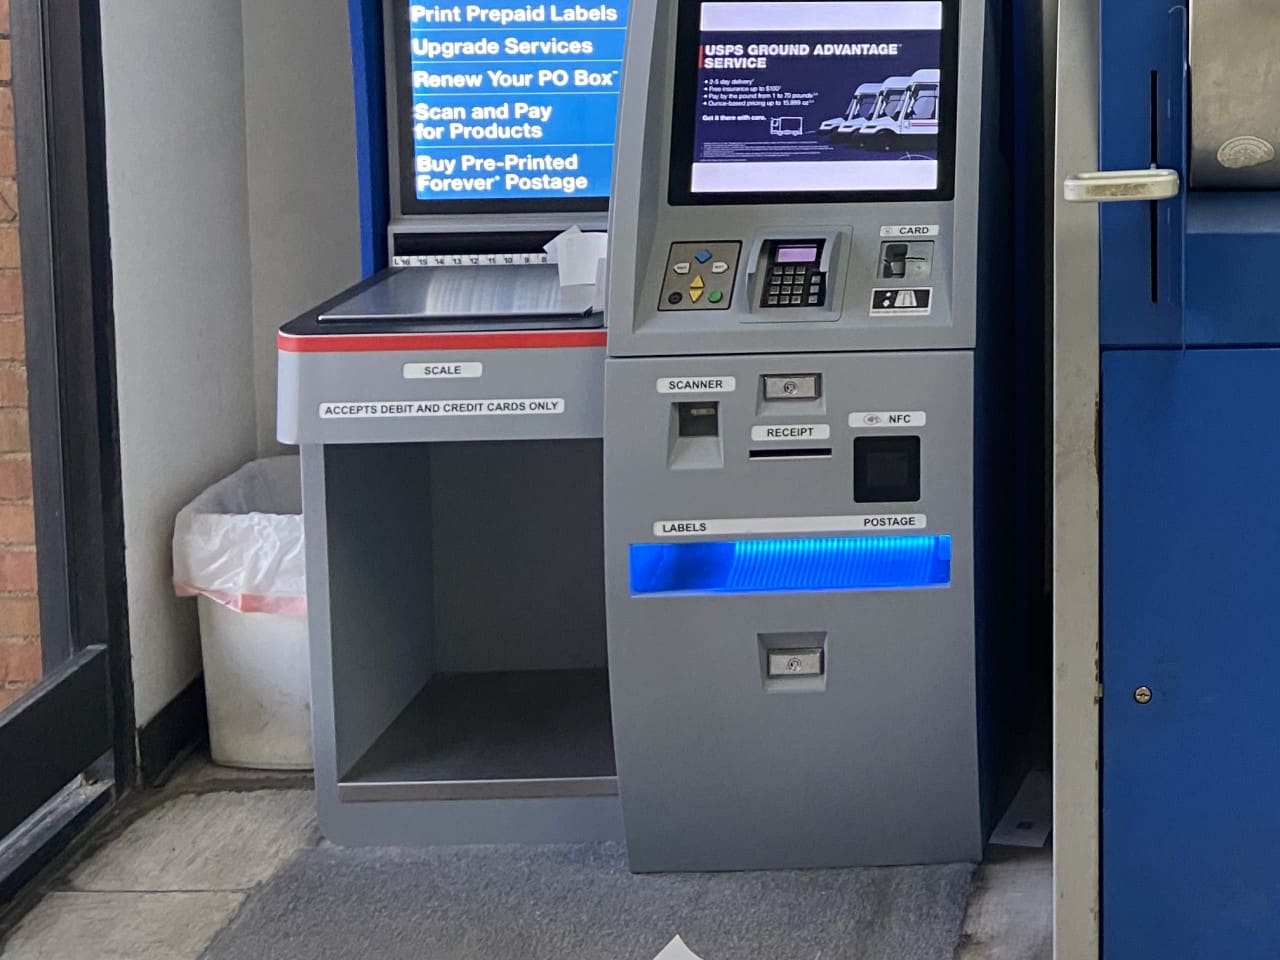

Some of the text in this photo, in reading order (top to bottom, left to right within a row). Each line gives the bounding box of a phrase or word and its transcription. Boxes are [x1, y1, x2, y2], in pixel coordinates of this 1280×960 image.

[410, 4, 617, 25] Print Prepaid Labels
[411, 37, 593, 59] Upgrade Services
[705, 44, 743, 56] USPS
[748, 44, 809, 56] GROUND
[704, 58, 766, 69] SERVICE
[413, 70, 482, 88] Renew
[488, 70, 533, 87] Your
[538, 69, 568, 86] PO
[414, 102, 552, 122] Scan and Pay
[414, 122, 543, 139] for Products
[416, 153, 578, 174] Buy Pre-Printed
[505, 174, 588, 193] Postage
[899, 226, 929, 235] CARD
[424, 365, 462, 375] SCALE
[669, 379, 723, 390] SCANNER
[325, 401, 558, 415] ACCEPTS DEBIT AND CREDIT CARDS ONLY
[888, 414, 911, 424] NFC
[767, 427, 814, 437] RECEIPT
[662, 522, 707, 532] LABELS
[863, 517, 916, 527] POSTAGE
